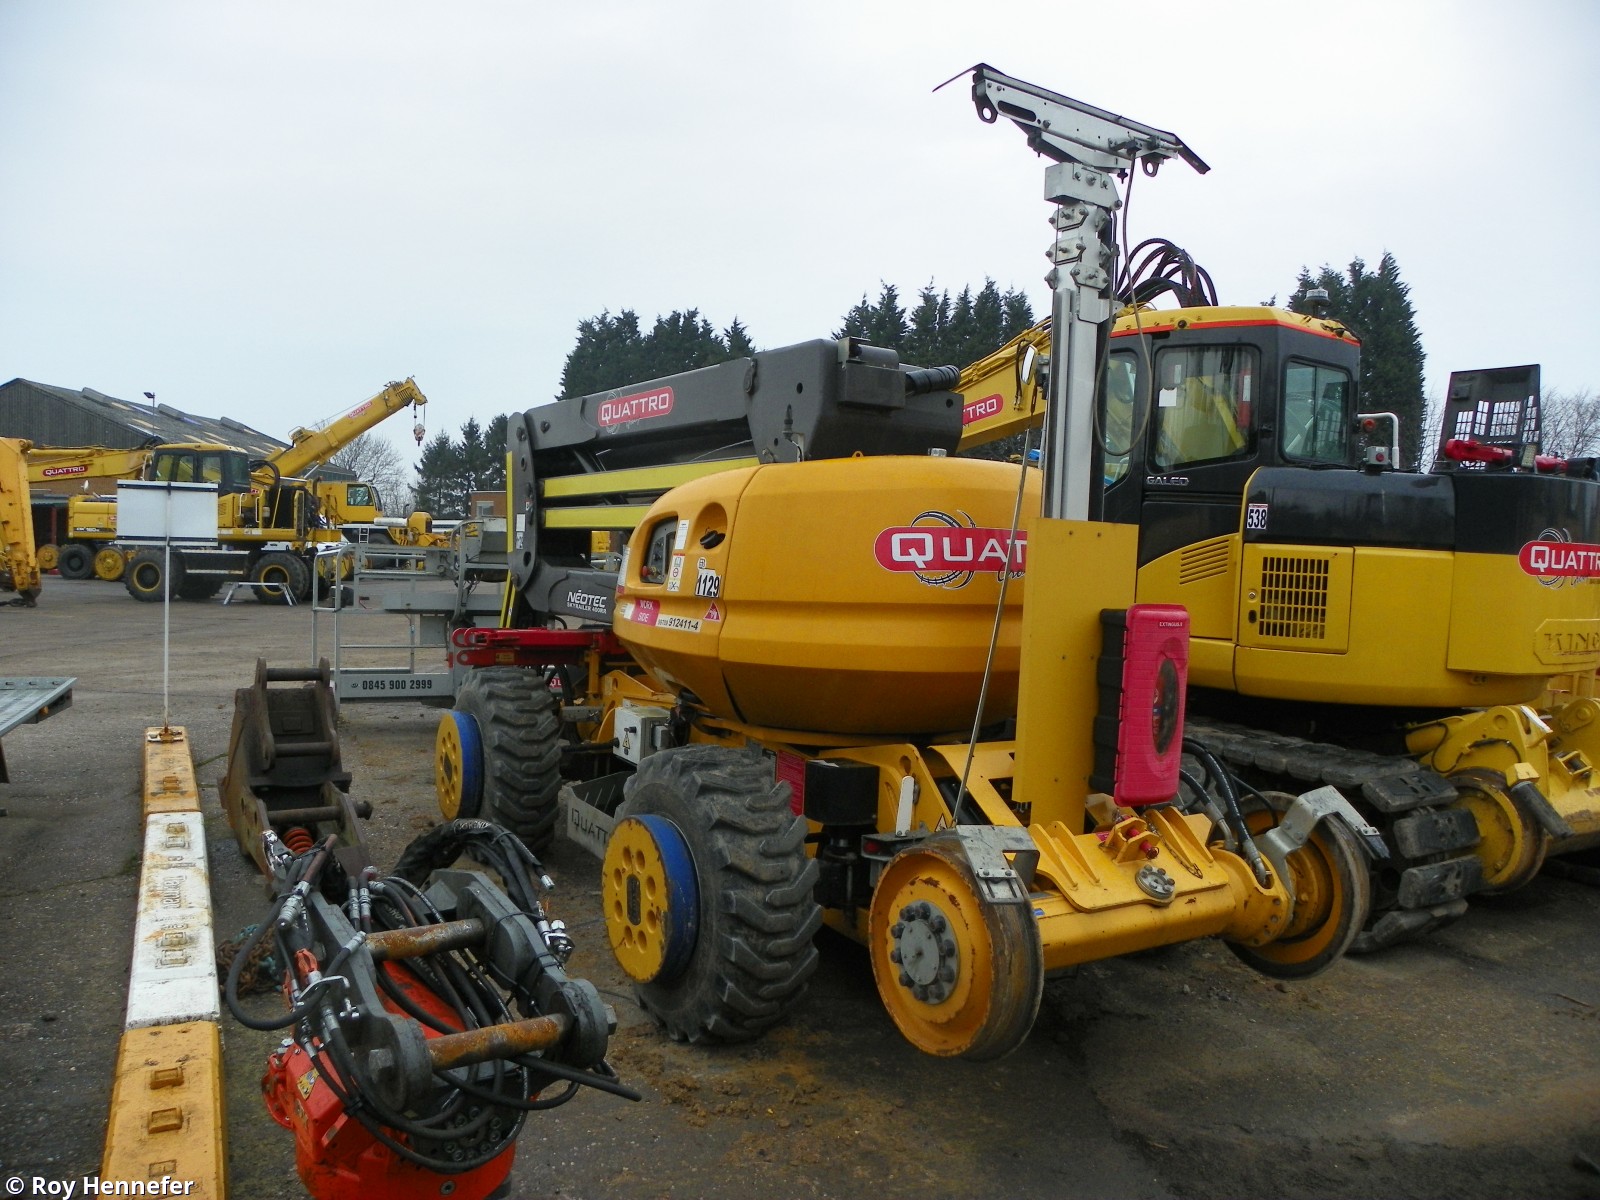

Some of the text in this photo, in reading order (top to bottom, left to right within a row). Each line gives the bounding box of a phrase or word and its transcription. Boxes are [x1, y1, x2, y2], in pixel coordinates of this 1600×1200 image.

[601, 393, 669, 423] QUATTRO
[963, 398, 997, 419] TRO
[45, 465, 85, 476] QUATTRO
[1248, 508, 1267, 529] 538
[696, 574, 720, 598] 1129
[567, 589, 607, 608] NÉOTEC
[640, 599, 654, 611] WORK
[637, 612, 650, 623] SIDE
[668, 617, 699, 630] 912411-4
[362, 679, 432, 690] 0845 900 2999
